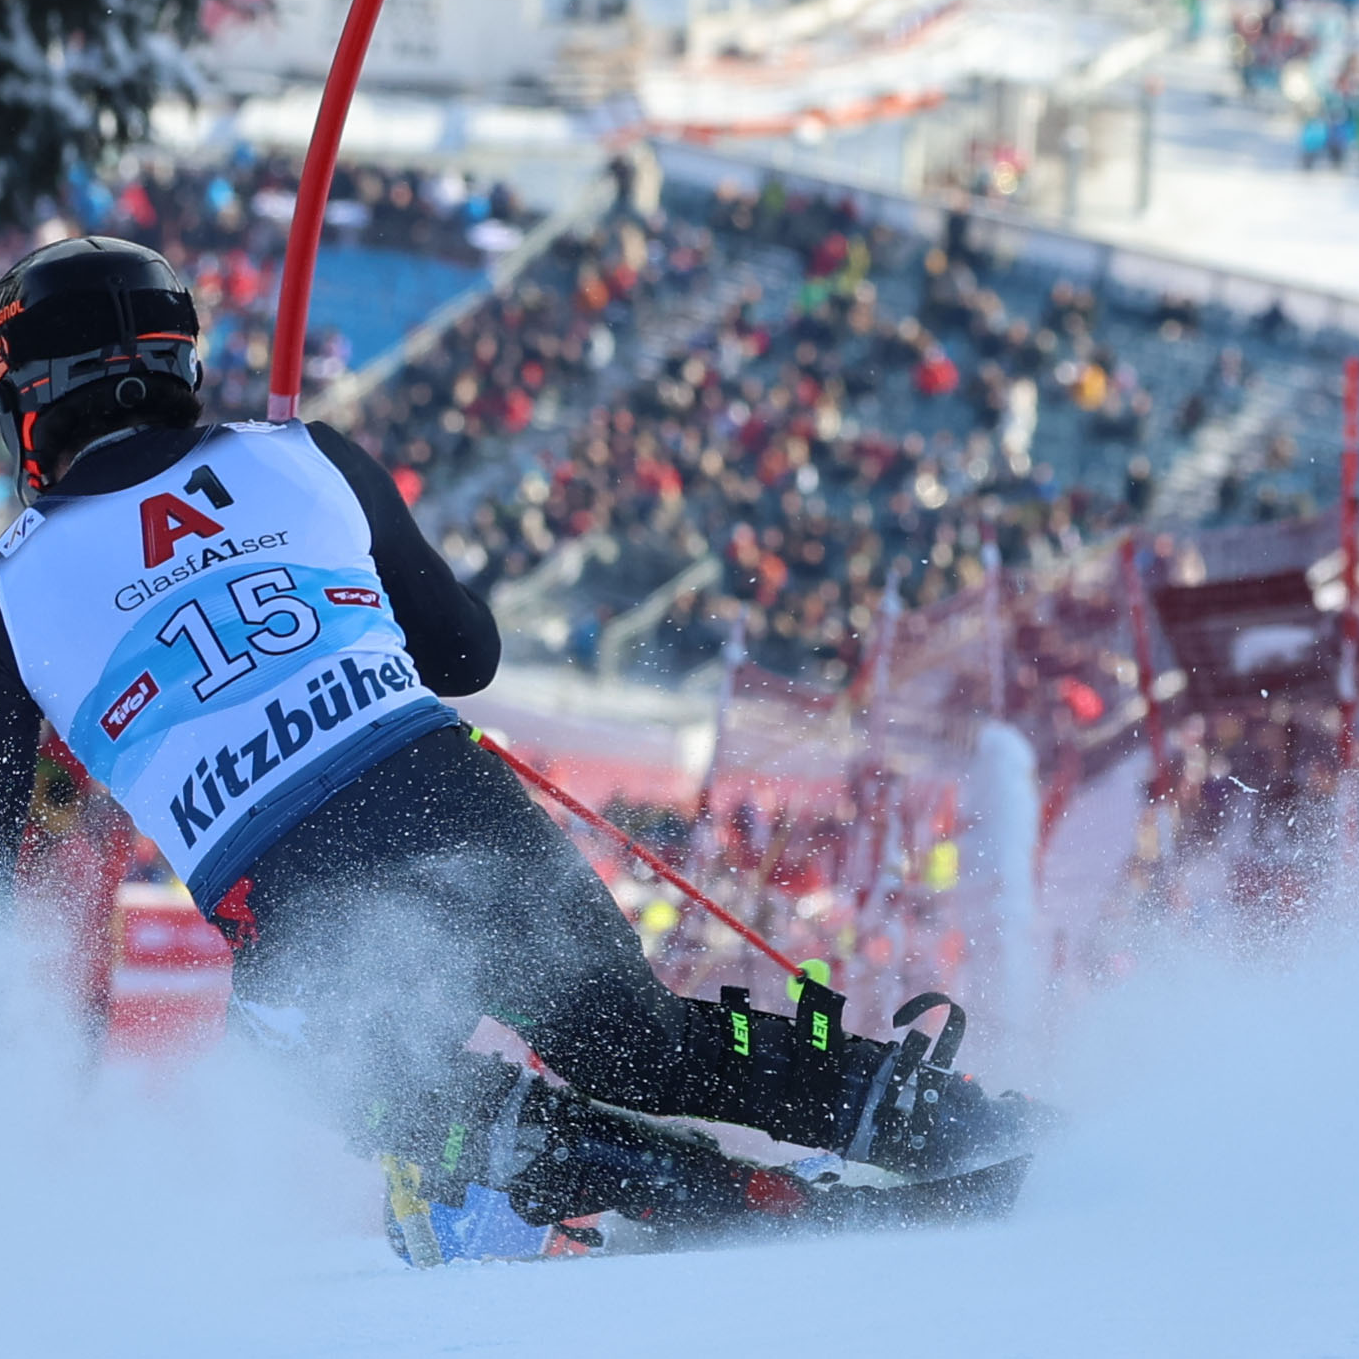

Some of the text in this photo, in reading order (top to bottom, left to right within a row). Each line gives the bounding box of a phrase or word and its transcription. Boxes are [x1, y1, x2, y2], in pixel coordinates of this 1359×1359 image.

[139, 464, 235, 570] A1
[114, 530, 290, 612] GlasfA1ser
[155, 566, 321, 704] 15
[169, 656, 415, 850] Kitzbühel
[731, 1011, 749, 1056] LEKI
[811, 1010, 828, 1051] LEKI
